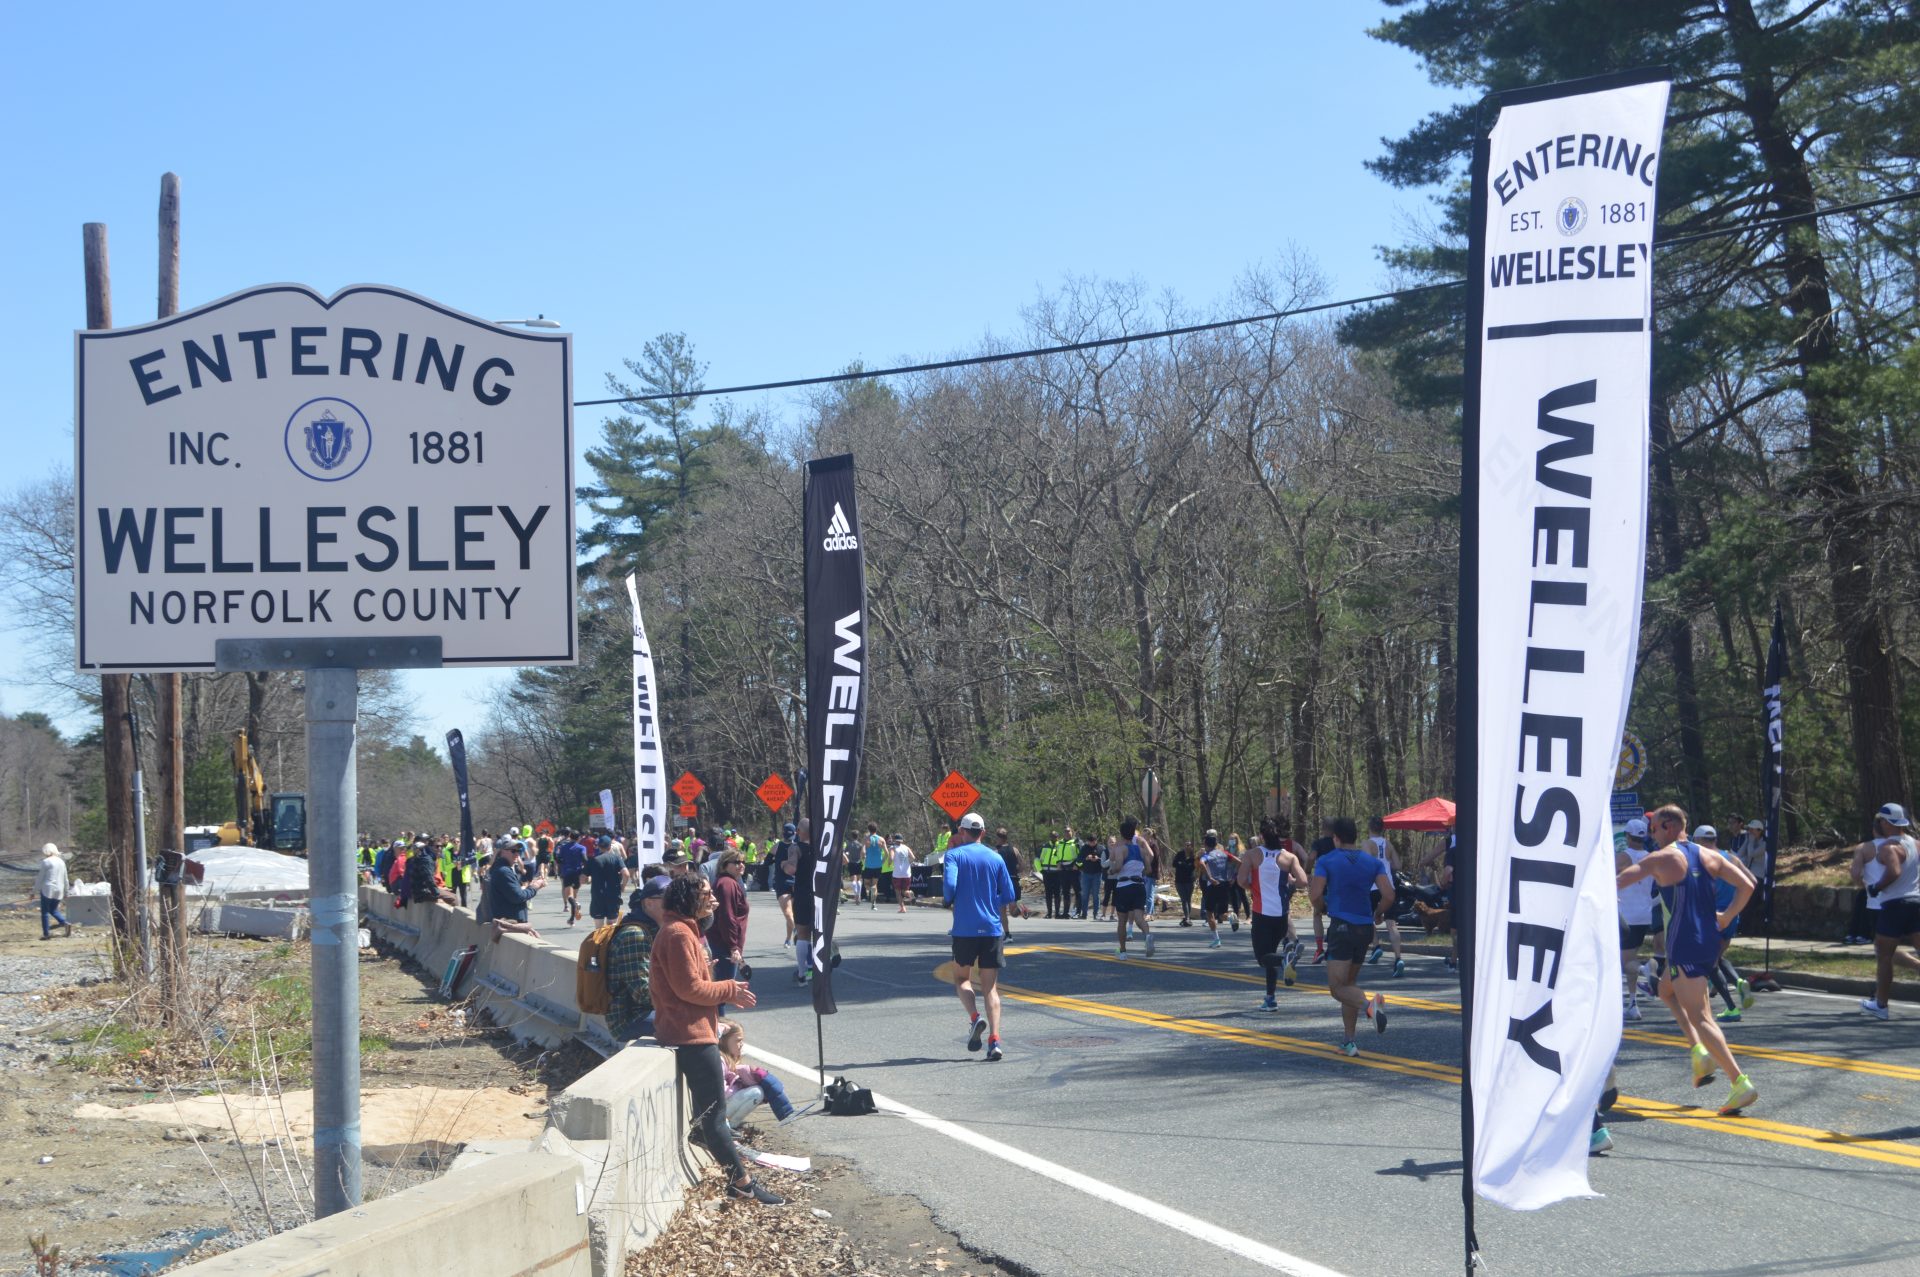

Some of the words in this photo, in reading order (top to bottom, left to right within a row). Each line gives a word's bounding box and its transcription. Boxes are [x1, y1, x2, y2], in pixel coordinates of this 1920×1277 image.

[1510, 211, 1544, 232] EST.
[1600, 201, 1646, 225] 1881
[129, 326, 515, 406] ENTERING
[168, 432, 242, 469] INC.
[409, 430, 484, 465] 1881
[97, 504, 551, 575] WELLESLEY
[823, 533, 858, 551] adidas
[130, 589, 334, 625] NORFOLK
[352, 586, 522, 622] COUNTY
[1507, 378, 1598, 1075] WELLESLEY
[942, 791, 969, 799] CLOSED
